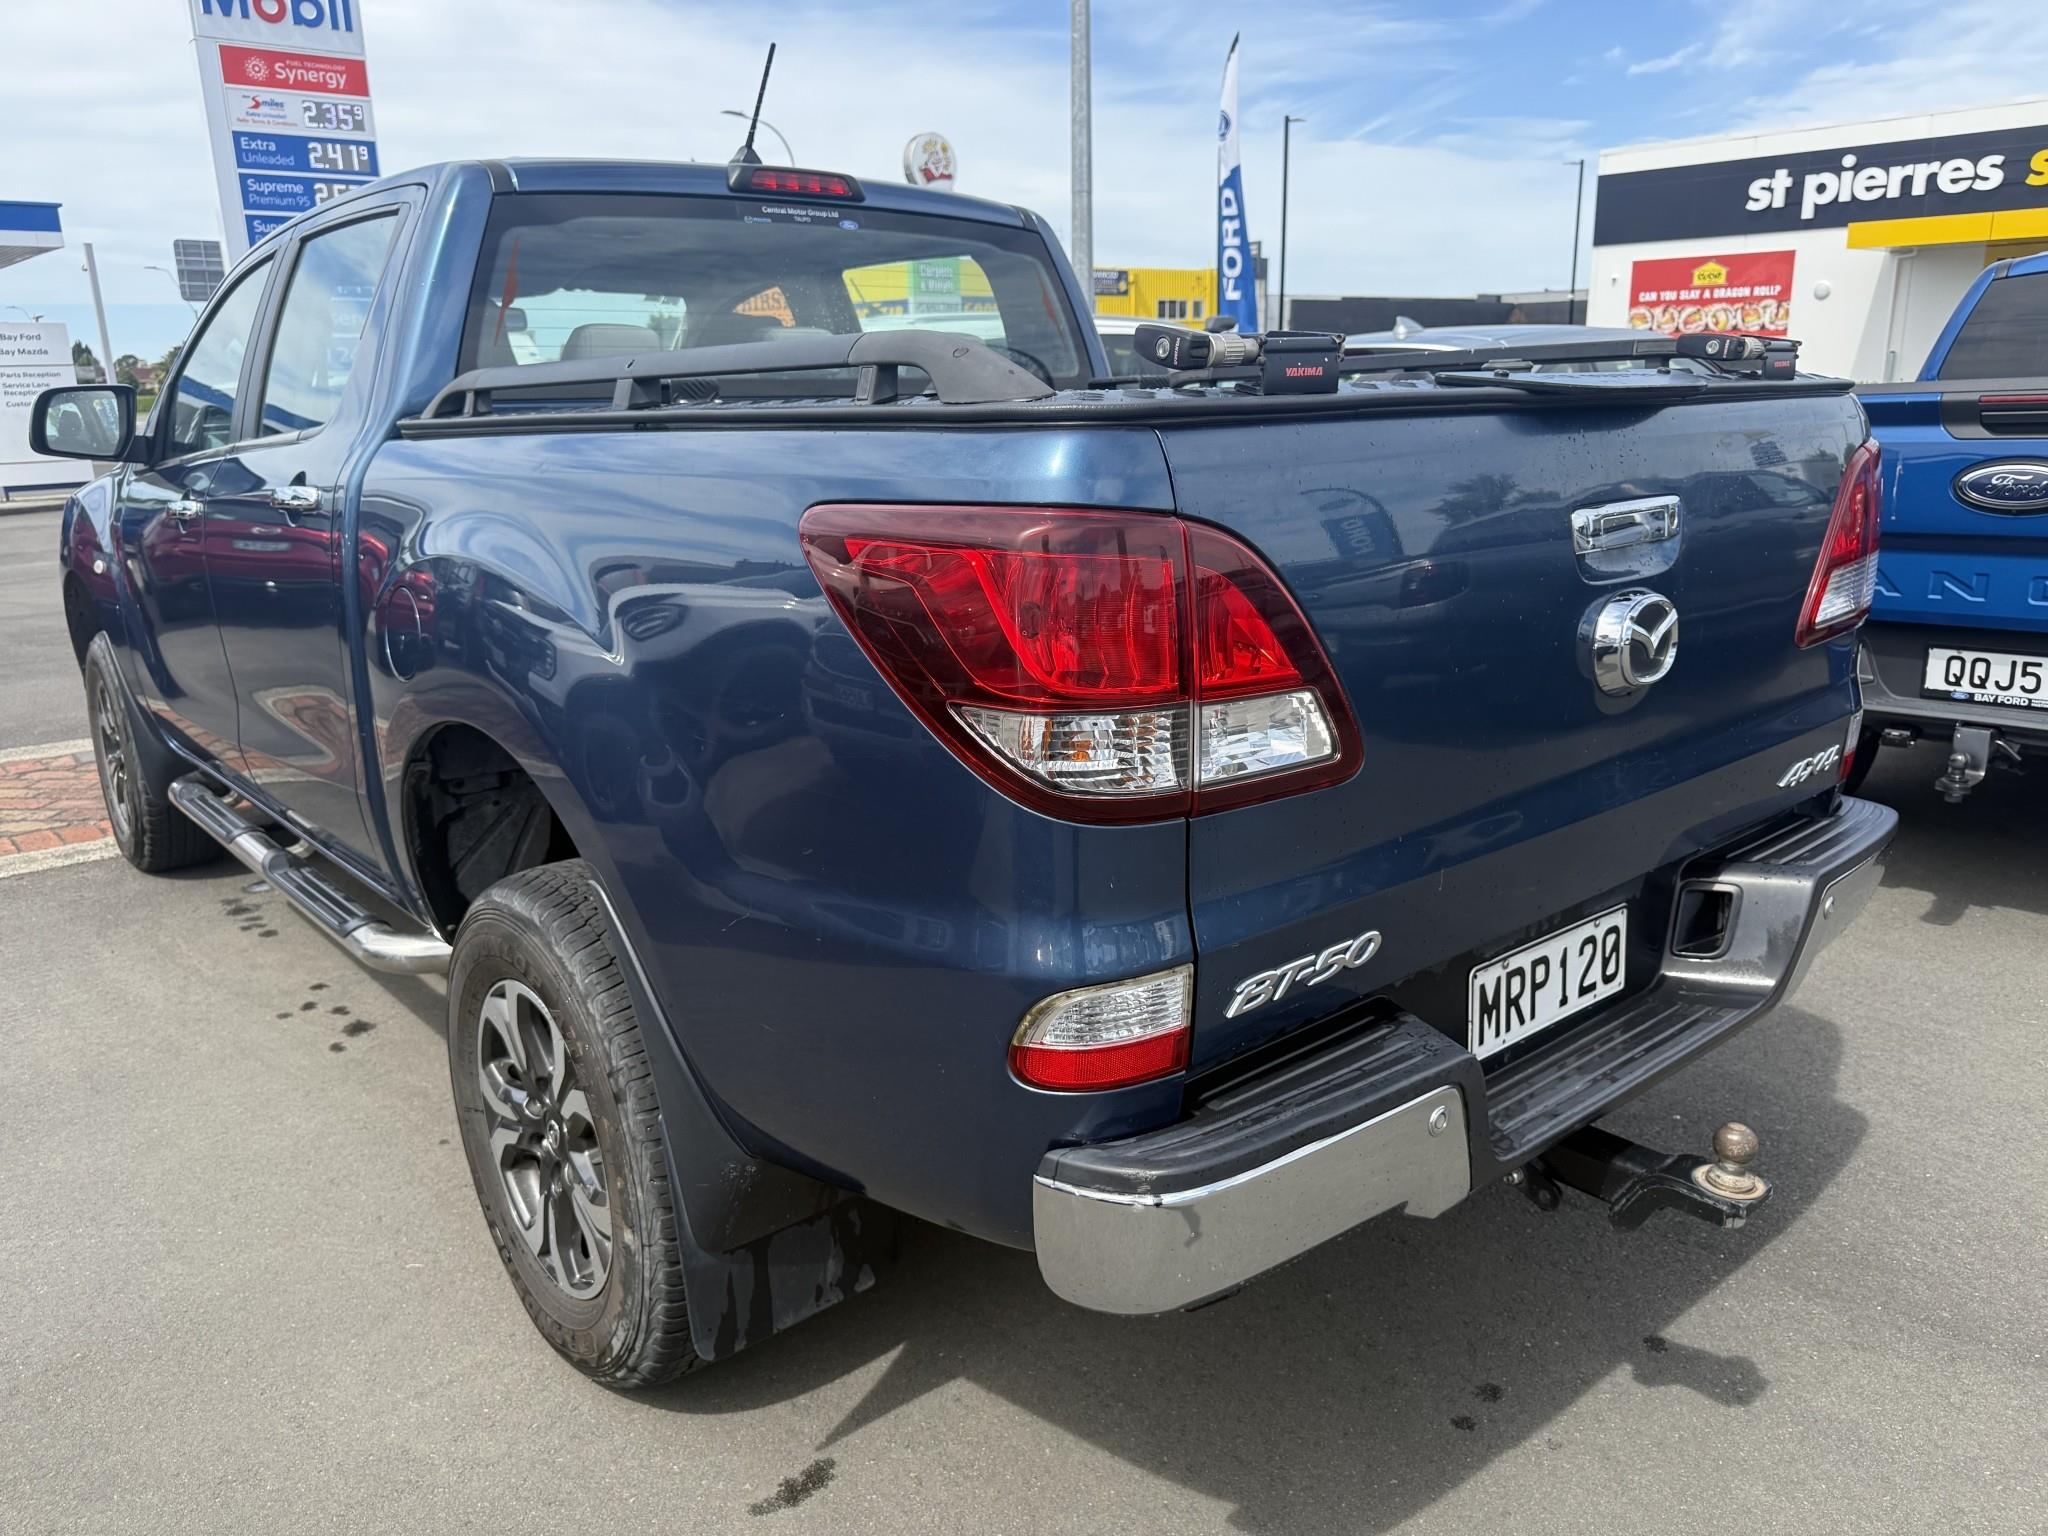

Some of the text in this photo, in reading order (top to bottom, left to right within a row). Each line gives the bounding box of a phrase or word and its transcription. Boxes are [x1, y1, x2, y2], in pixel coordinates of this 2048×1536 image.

[274, 62, 347, 89] Synergy
[248, 95, 285, 110] Smiles
[240, 137, 276, 152] Extra
[242, 152, 295, 166] Unleaded
[247, 178, 304, 194] Supreme
[1745, 169, 1793, 211] st
[1801, 154, 2005, 220] pierres
[248, 193, 311, 207] Premium 95
[761, 206, 787, 214] Central
[808, 209, 827, 218] Group
[253, 219, 281, 233] Sup
[1220, 187, 1243, 301] FORD
[1639, 285, 1781, 302] CAN YOU SLAY A DRAGON ROLL?
[20, 333, 41, 341] Ford
[18, 347, 48, 355] Mazda
[1285, 366, 1323, 377] YAKIMA
[1944, 655, 2043, 694] QQJ5
[1974, 693, 1996, 703] BAY
[1997, 696, 2029, 707] FORD
[1225, 930, 1383, 1019] BT-50
[1477, 924, 1621, 1047] MRP120
